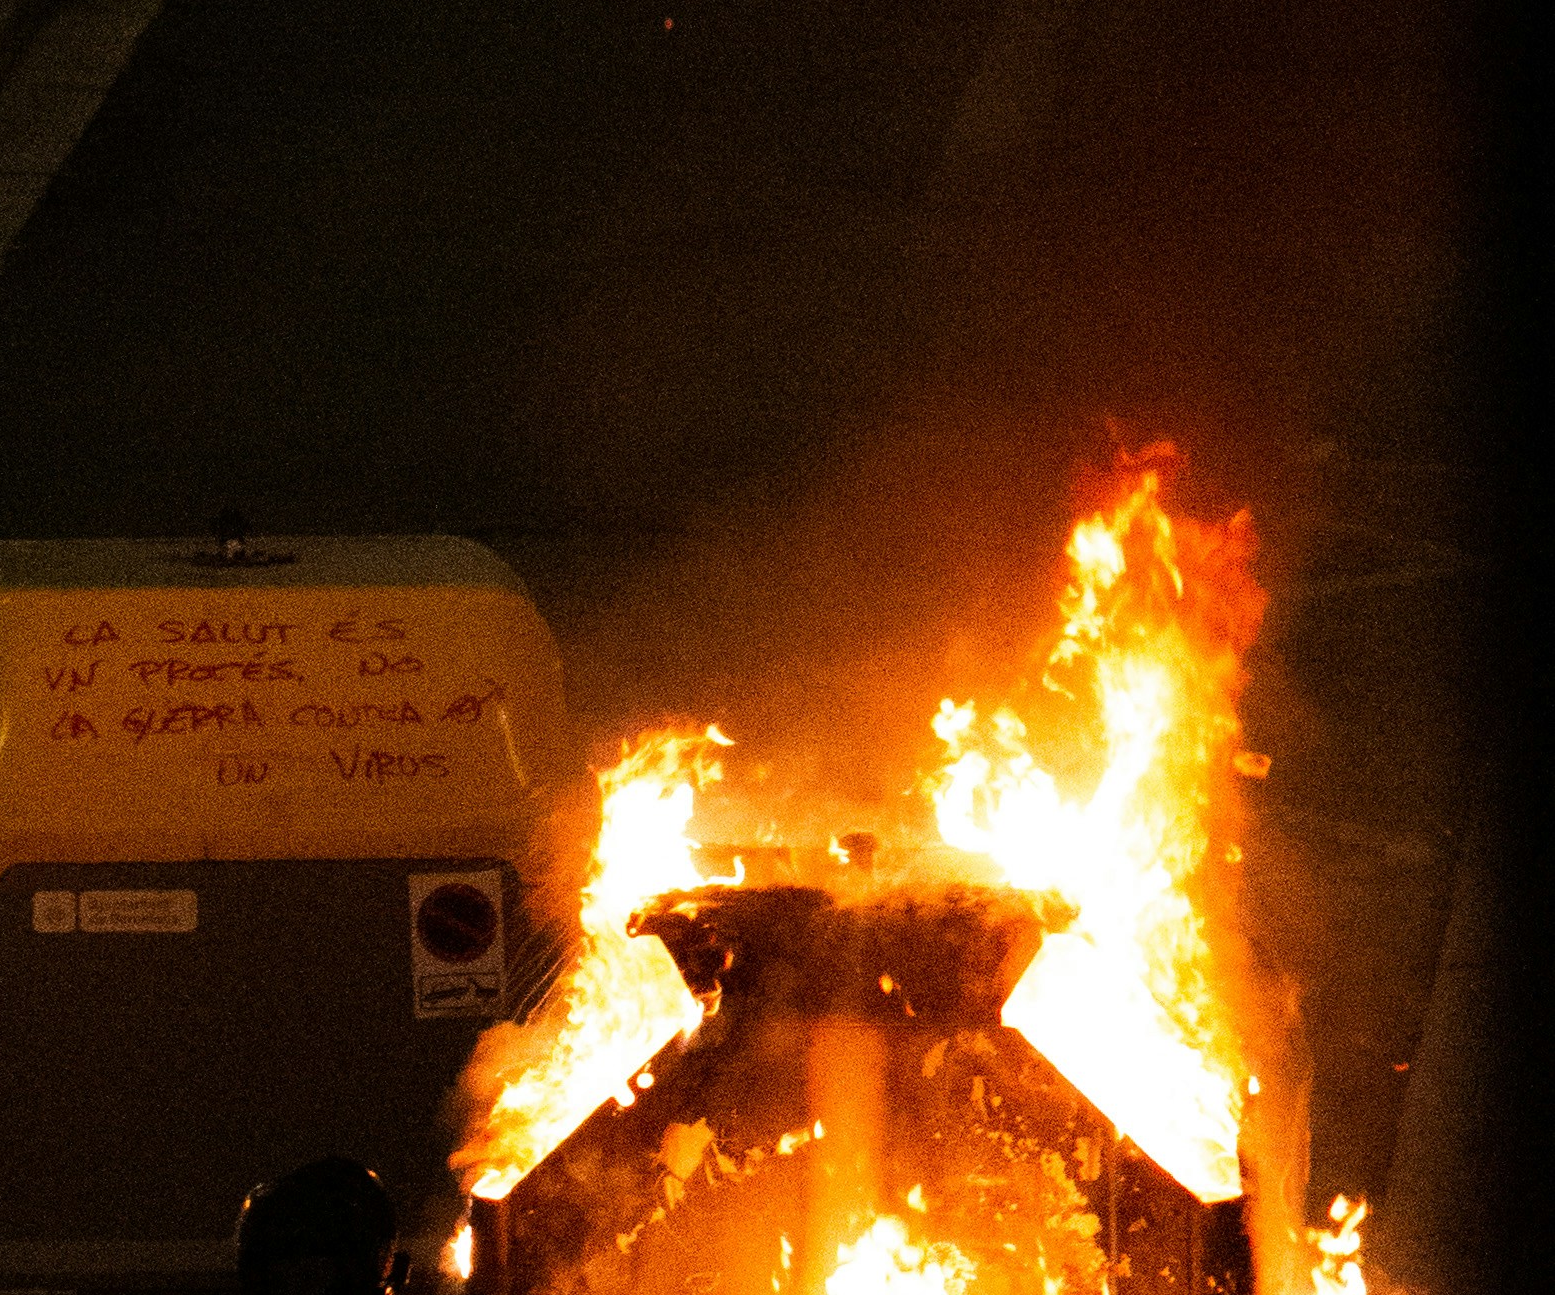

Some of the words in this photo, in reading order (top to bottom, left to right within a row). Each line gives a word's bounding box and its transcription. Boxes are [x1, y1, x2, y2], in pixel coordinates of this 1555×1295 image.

[64, 621, 119, 645] LA
[157, 619, 301, 644] SALUT
[329, 608, 405, 643] ÉS
[358, 651, 424, 677] NO
[50, 710, 99, 740] LA
[289, 701, 422, 728] CONTRA
[217, 754, 269, 787] UN
[329, 743, 450, 785] VIRUS
